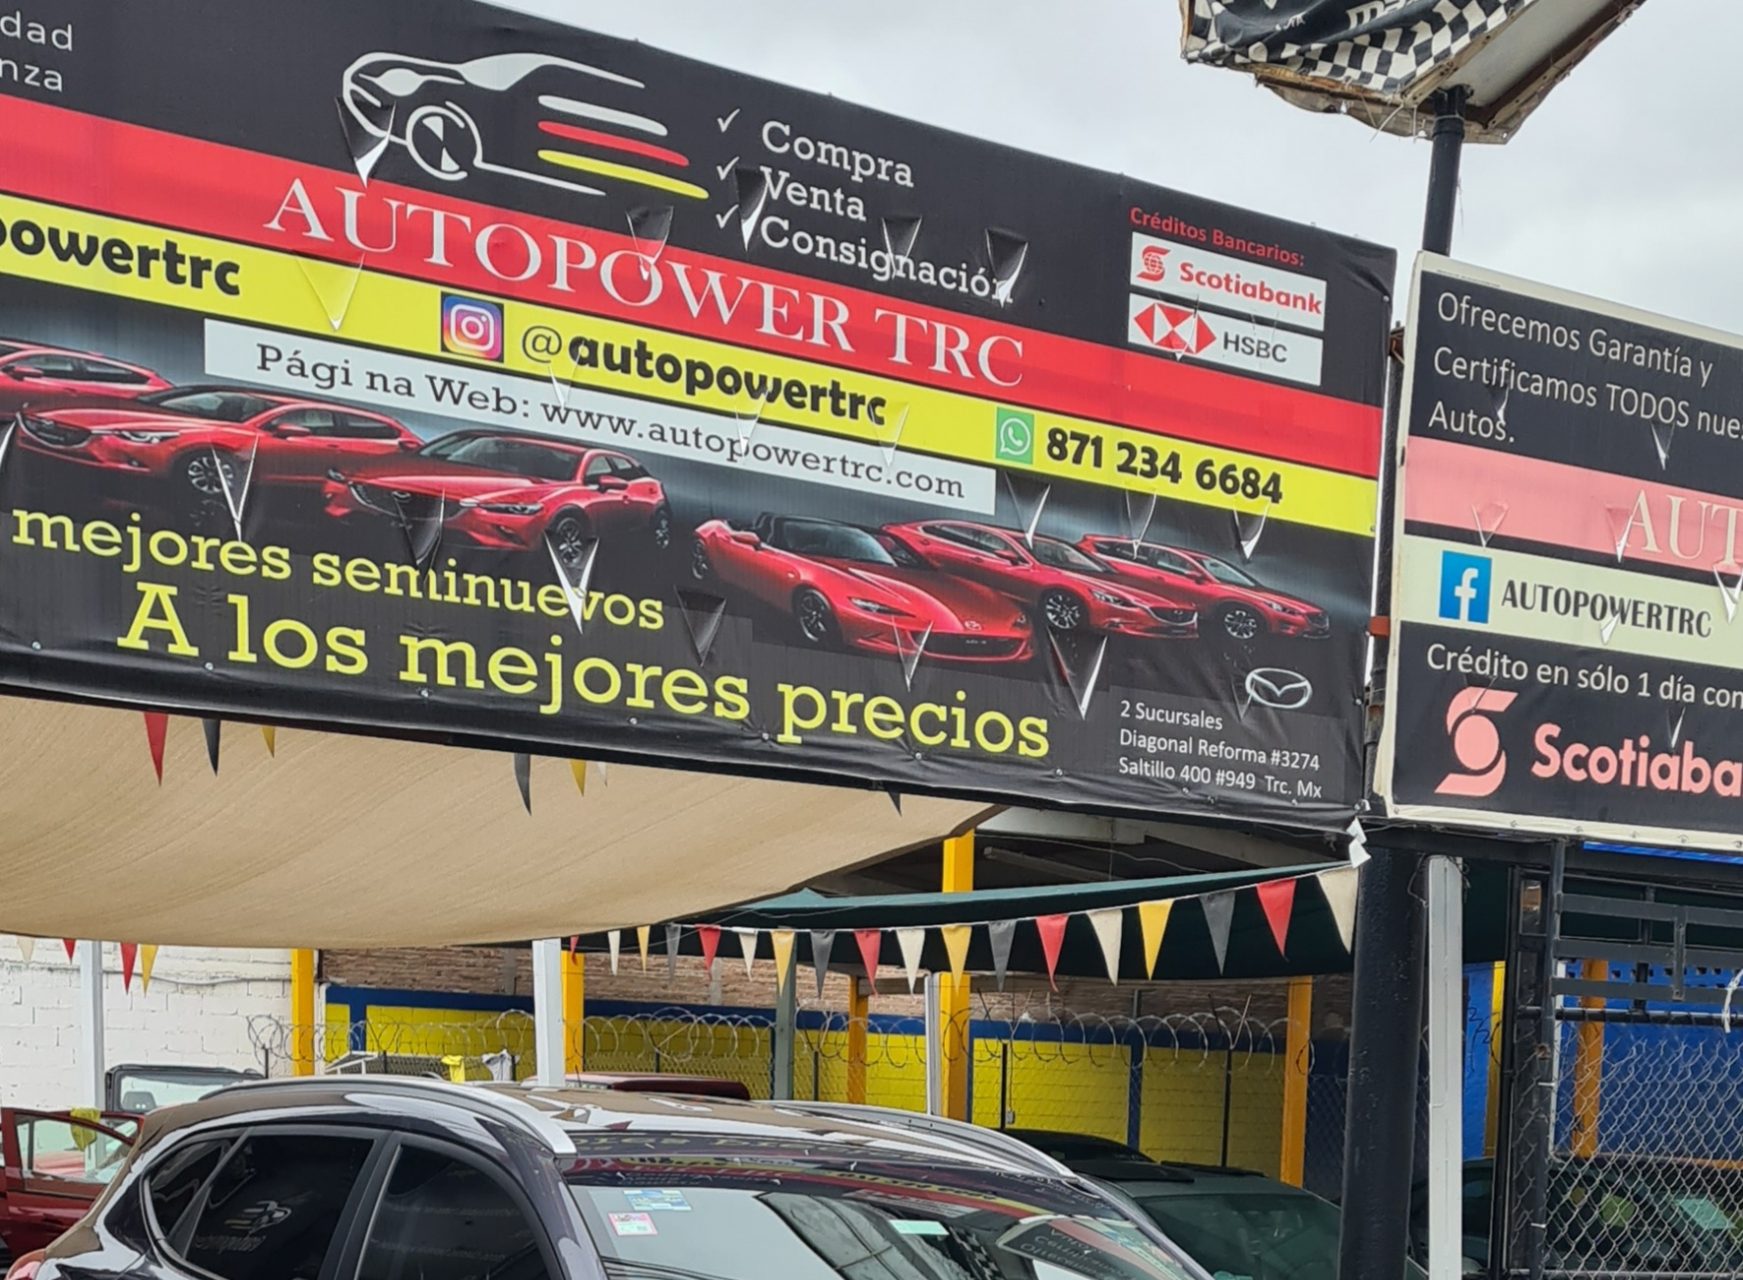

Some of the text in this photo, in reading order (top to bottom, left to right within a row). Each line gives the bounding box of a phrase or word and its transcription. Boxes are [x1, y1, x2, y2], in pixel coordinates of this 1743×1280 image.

[0, 10, 73, 52] dad
[761, 120, 914, 188] Compra
[760, 165, 867, 222] Venta
[0, 217, 241, 297] owertrc
[1129, 206, 1305, 267] Créditos Bancarios:
[262, 177, 1024, 387] AUTOPOWER TRC
[1179, 261, 1323, 315] Scotiabank
[1222, 331, 1288, 363] HSBC
[1437, 291, 1713, 389] Ofrecemos Garantía y
[521, 324, 888, 428] @autopowertrc
[1433, 346, 1743, 441] Certificamos TODOS nue
[256, 342, 965, 500] Pági na Web: www.autopowertrc.com
[1428, 400, 1516, 443] Autos.
[1046, 427, 1283, 505] 871 234 6684
[12, 508, 665, 630] mejores seminuevos
[1501, 580, 1712, 639] AUTOPOWERTRC
[116, 580, 1050, 759] A los mejores precios
[1426, 643, 1529, 681] Crédito
[1536, 662, 1570, 686] en
[1577, 664, 1630, 695] sólo
[1638, 671, 1651, 697] 1
[1659, 674, 1696, 703] día
[1120, 700, 1223, 731] 2 Sucursales
[1119, 728, 1320, 771] Diagonal Reforma #3274
[1119, 757, 1322, 799] Saltillo 400 #949 Trc. Mx
